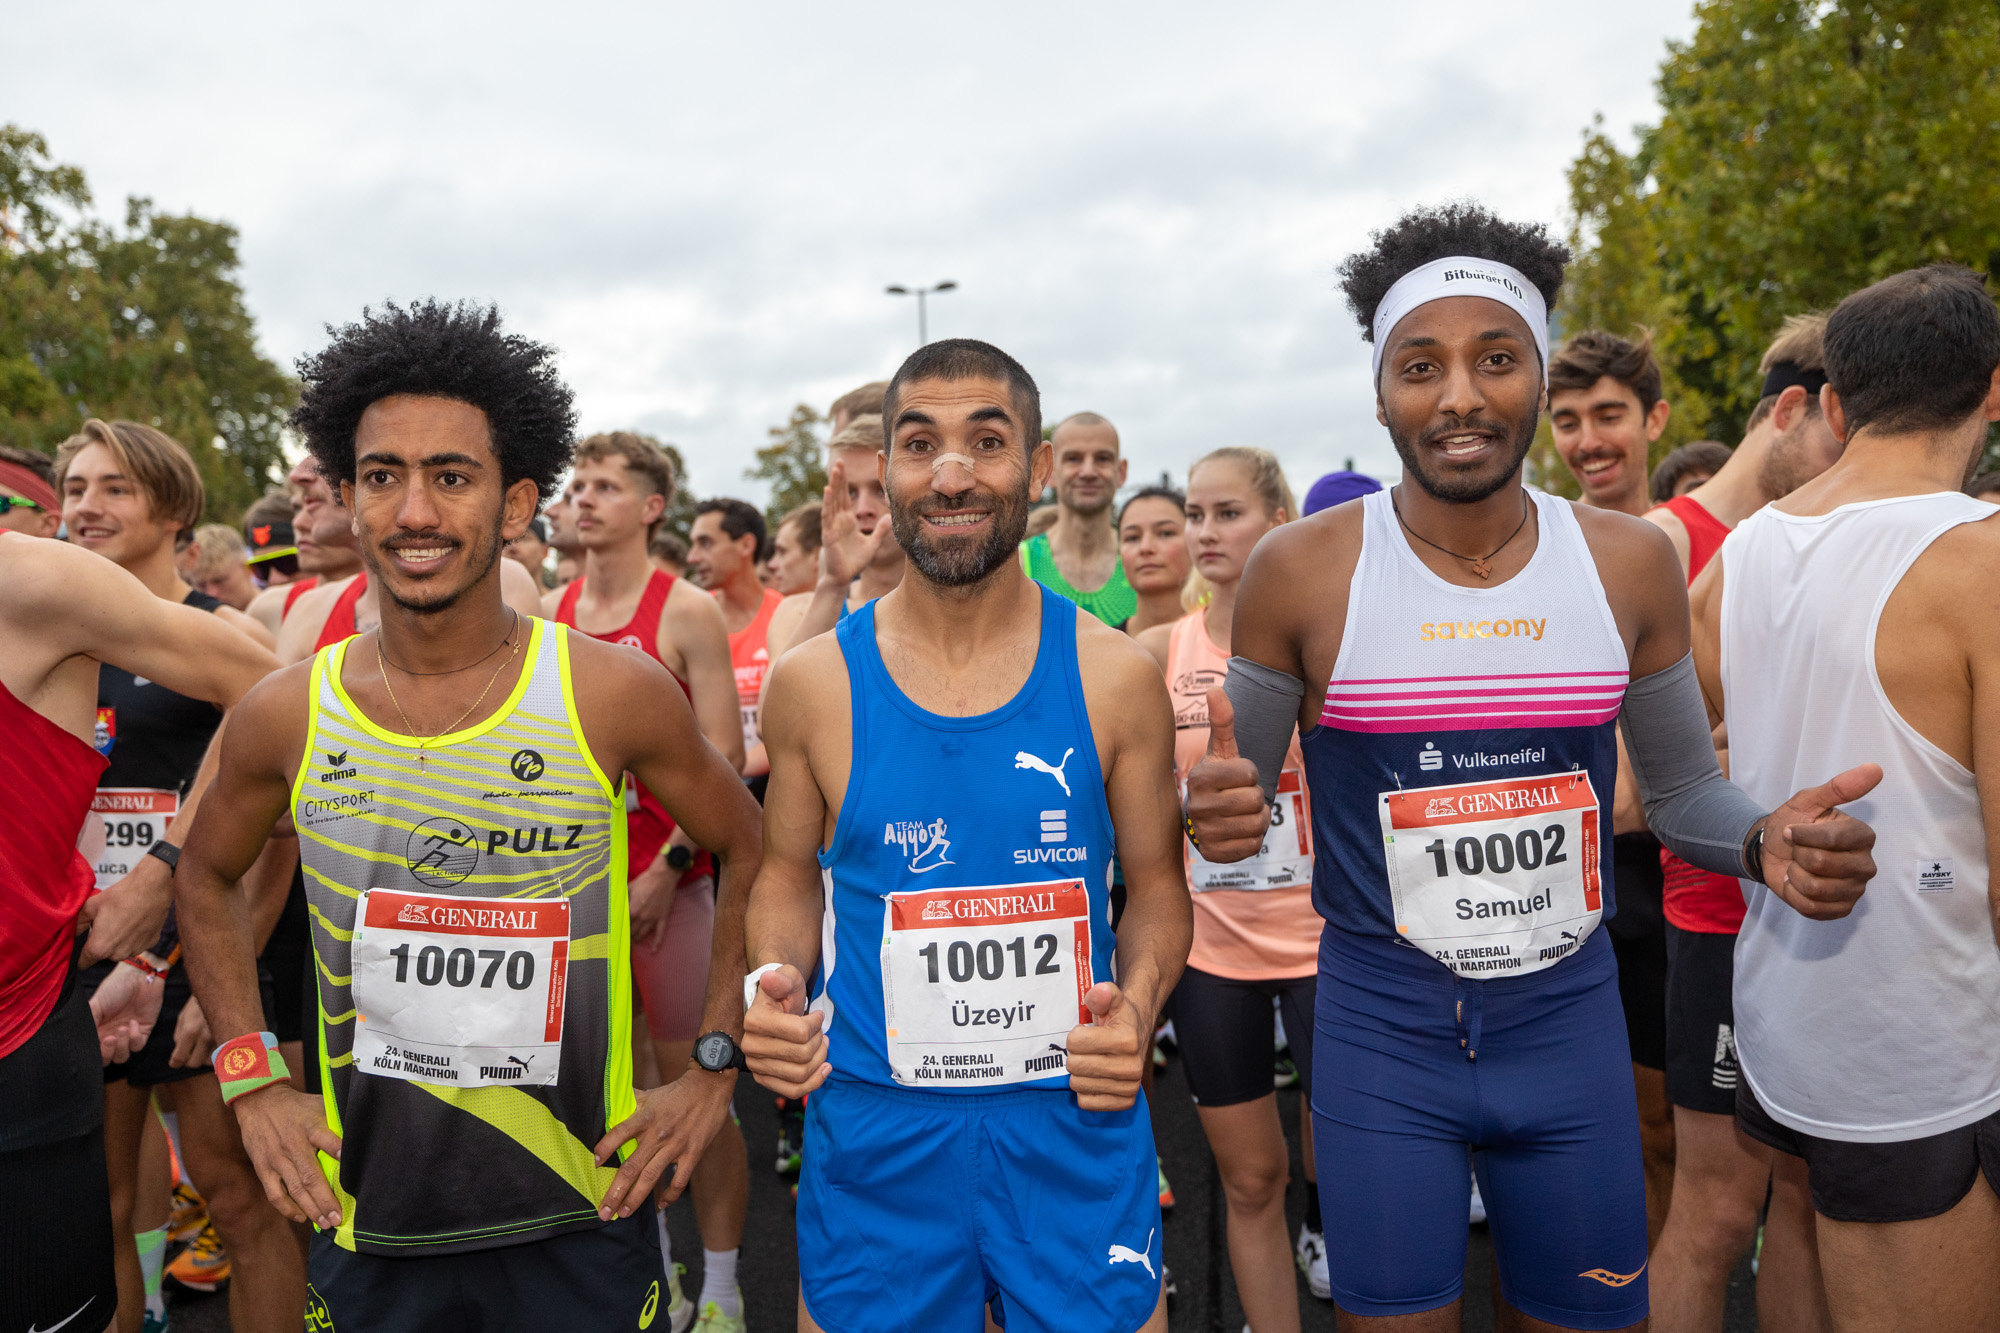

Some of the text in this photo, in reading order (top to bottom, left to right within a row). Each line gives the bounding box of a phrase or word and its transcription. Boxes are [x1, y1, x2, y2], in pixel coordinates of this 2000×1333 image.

[1443, 269, 1502, 285] Bitburger
[1420, 618, 1547, 641] saucony
[1452, 747, 1546, 769] Vulkaneifel
[321, 768, 357, 783] erima
[305, 790, 375, 817] CITYSPORT
[1458, 786, 1562, 815] GENERALI
[104, 821, 153, 847] 299
[895, 820, 924, 831] TEAM
[487, 824, 584, 856] PULZ
[1425, 823, 1568, 878] 10002
[1013, 846, 1087, 864] SUVICOM
[953, 892, 1056, 919] GENERALI
[1455, 887, 1552, 921] Samuel
[431, 906, 538, 930] GENERALI
[918, 933, 1061, 984] 10012
[1435, 945, 1511, 961] 24. GENERALI
[1460, 957, 1521, 971] MARATHON
[389, 943, 535, 991] 10070
[952, 1000, 1036, 1030] Üzeyir
[385, 1045, 450, 1067] 24. GENERALI
[709, 1039, 721, 1059] 0:00
[922, 1053, 994, 1066] 24. GENERALI
[373, 1056, 458, 1080] KÖLN MARATHON
[480, 1066, 522, 1080] PUMA
[914, 1066, 1004, 1079] KÖLN MARATHON
[1025, 1054, 1064, 1073] PUMA
